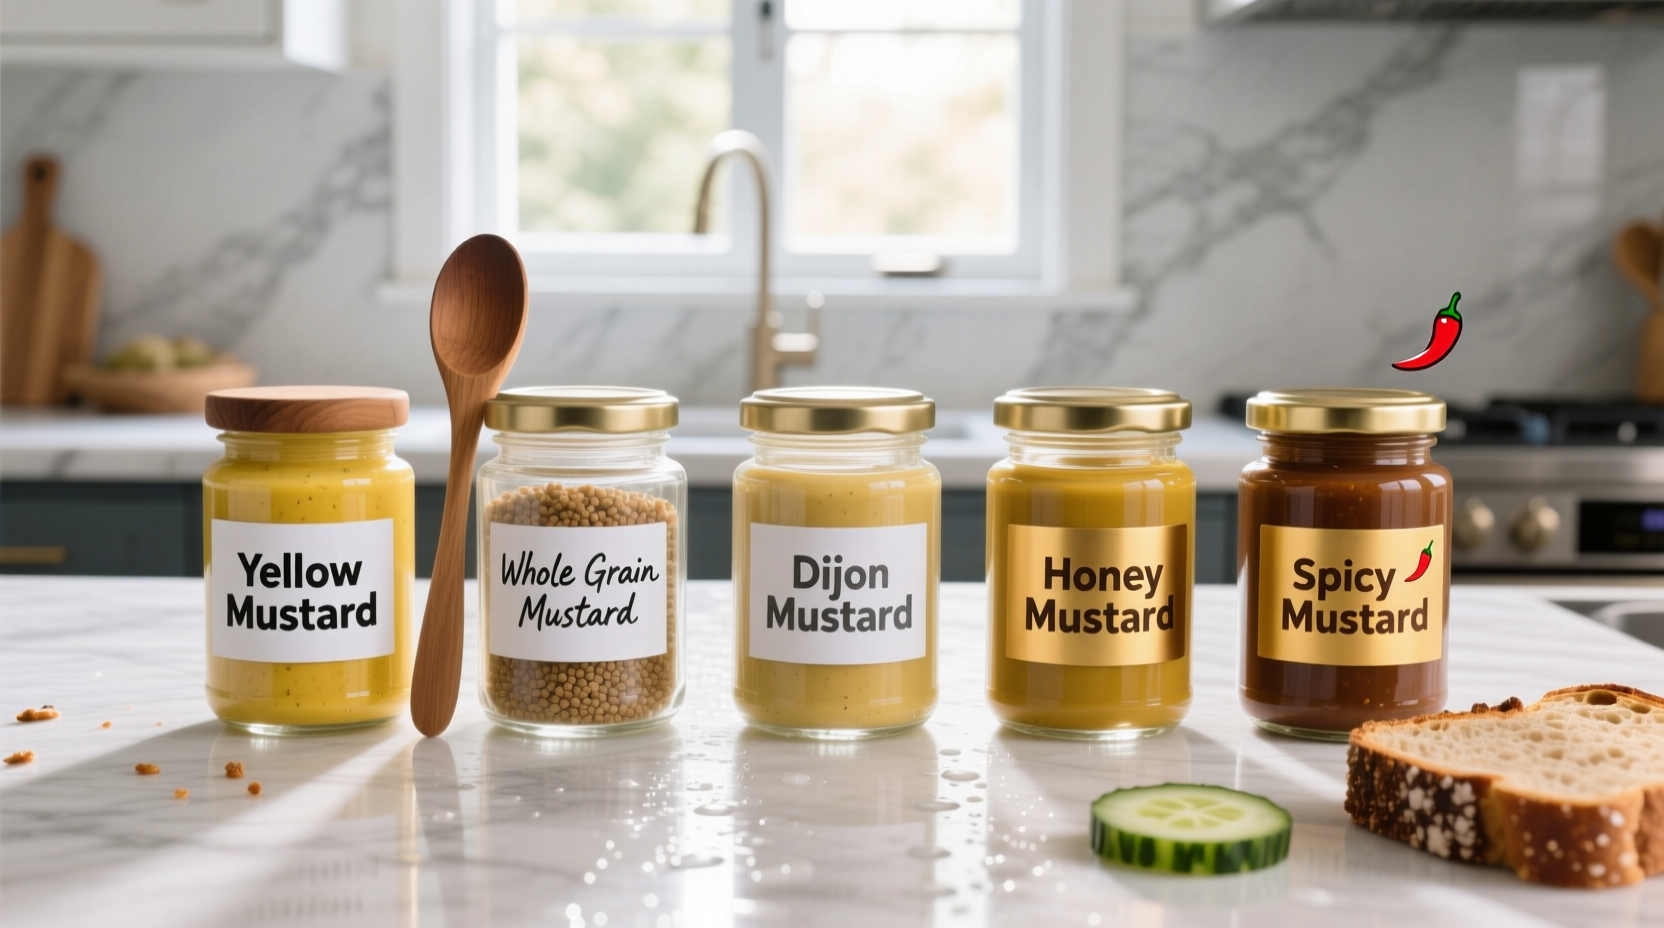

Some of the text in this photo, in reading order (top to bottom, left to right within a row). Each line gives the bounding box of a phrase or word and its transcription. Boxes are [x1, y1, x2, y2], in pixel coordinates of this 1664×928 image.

[236, 552, 363, 589] Yellow
[501, 550, 660, 593] Whole Grain
[792, 554, 889, 601] Dijon
[1044, 556, 1164, 599] Honey
[1293, 557, 1397, 602] Spicy
[226, 590, 377, 632] Mustard
[518, 591, 639, 632] Mustard
[766, 593, 913, 633] Mustard
[1025, 594, 1174, 634] Mustard
[1281, 597, 1428, 636] Mustard
